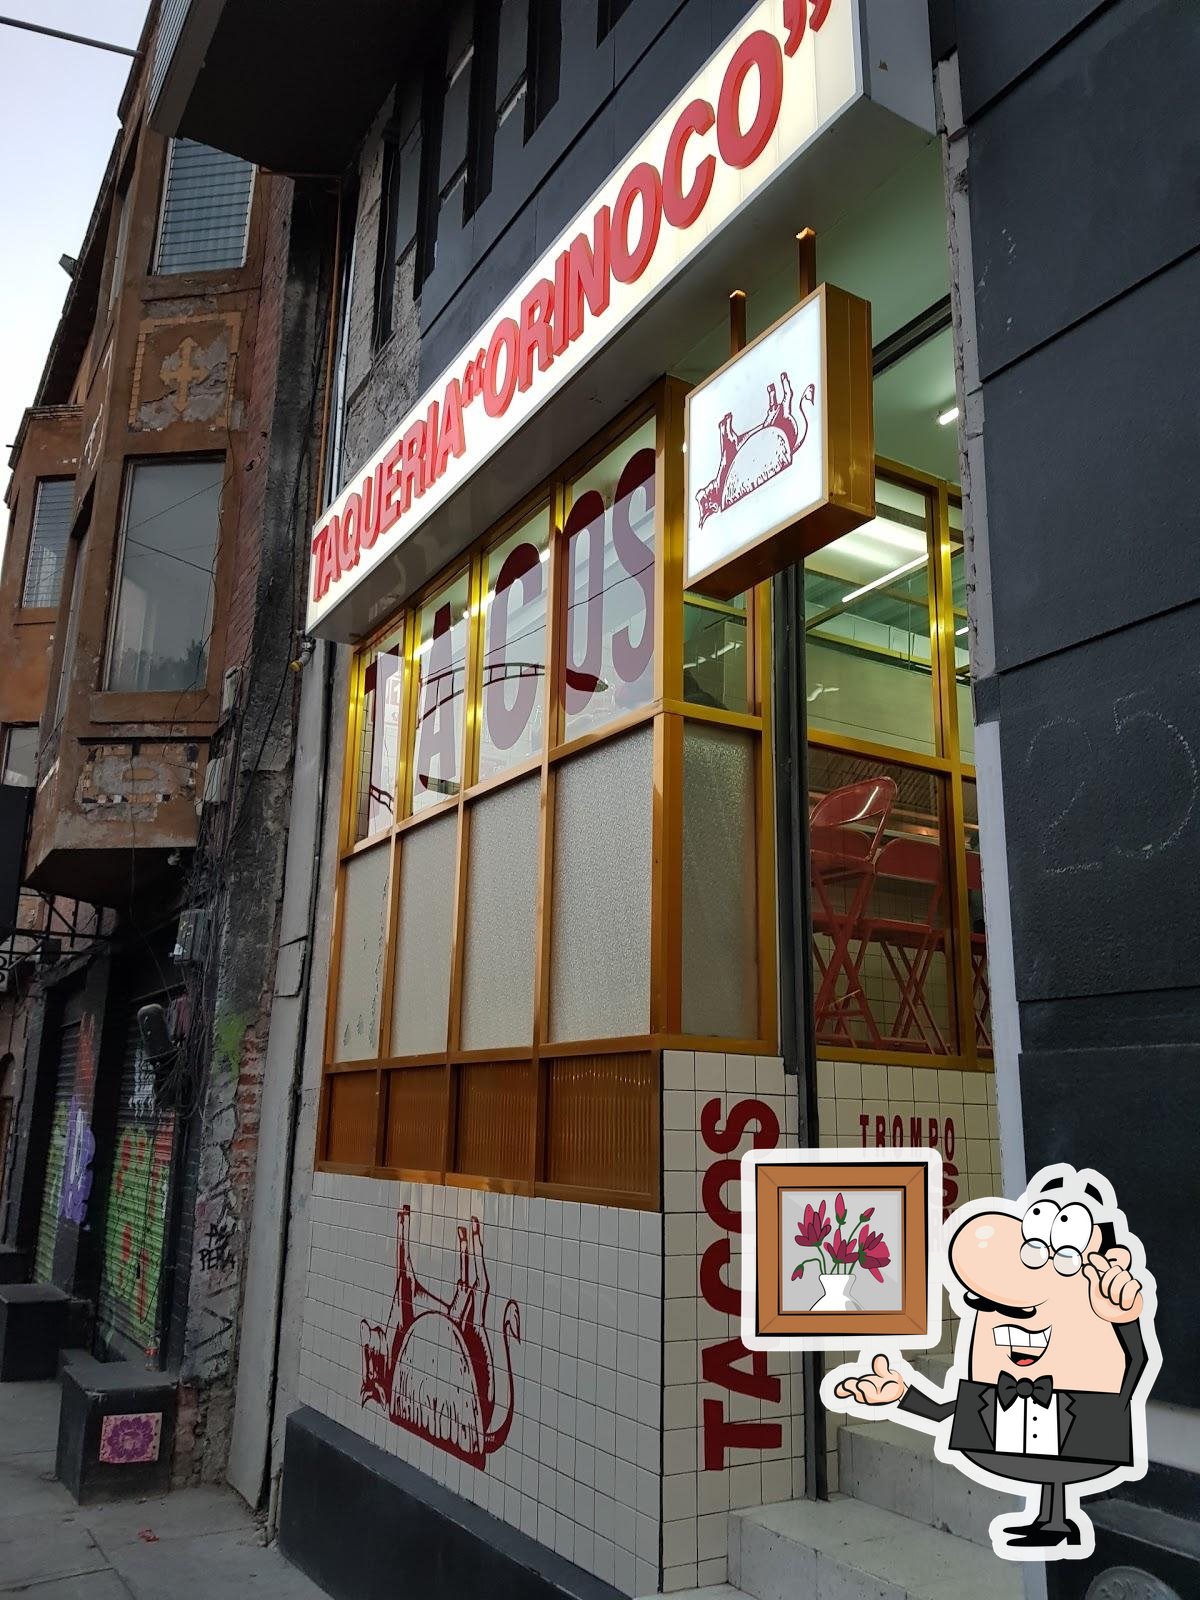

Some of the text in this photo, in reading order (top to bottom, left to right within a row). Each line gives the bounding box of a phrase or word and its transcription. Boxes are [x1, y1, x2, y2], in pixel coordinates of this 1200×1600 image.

[312, 378, 466, 603] TAQUERIA
[356, 447, 657, 820] TACOS
[859, 1114, 956, 1161] TROMPO
